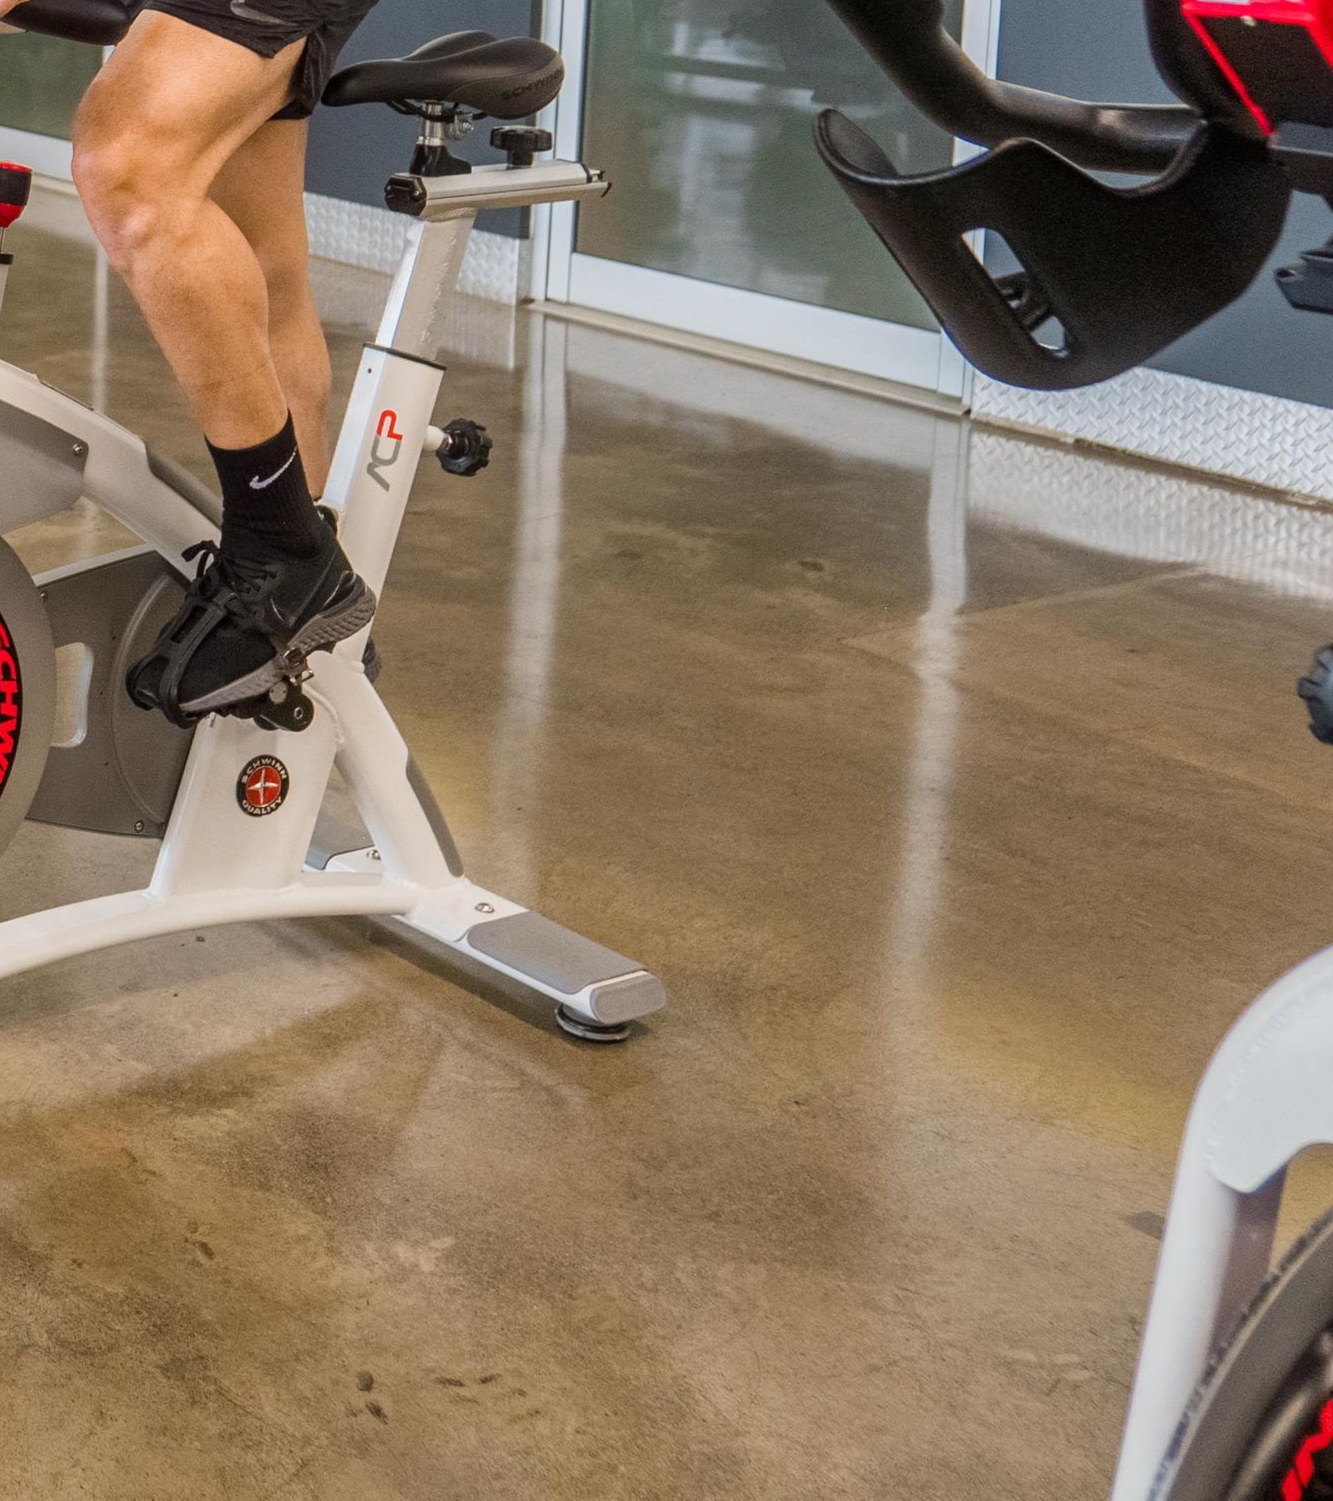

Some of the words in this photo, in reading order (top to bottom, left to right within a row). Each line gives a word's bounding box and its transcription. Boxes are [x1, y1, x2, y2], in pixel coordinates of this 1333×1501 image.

[366, 409, 403, 493] ACP
[241, 758, 287, 783] SCHWINN
[242, 796, 282, 815] QUALITY
